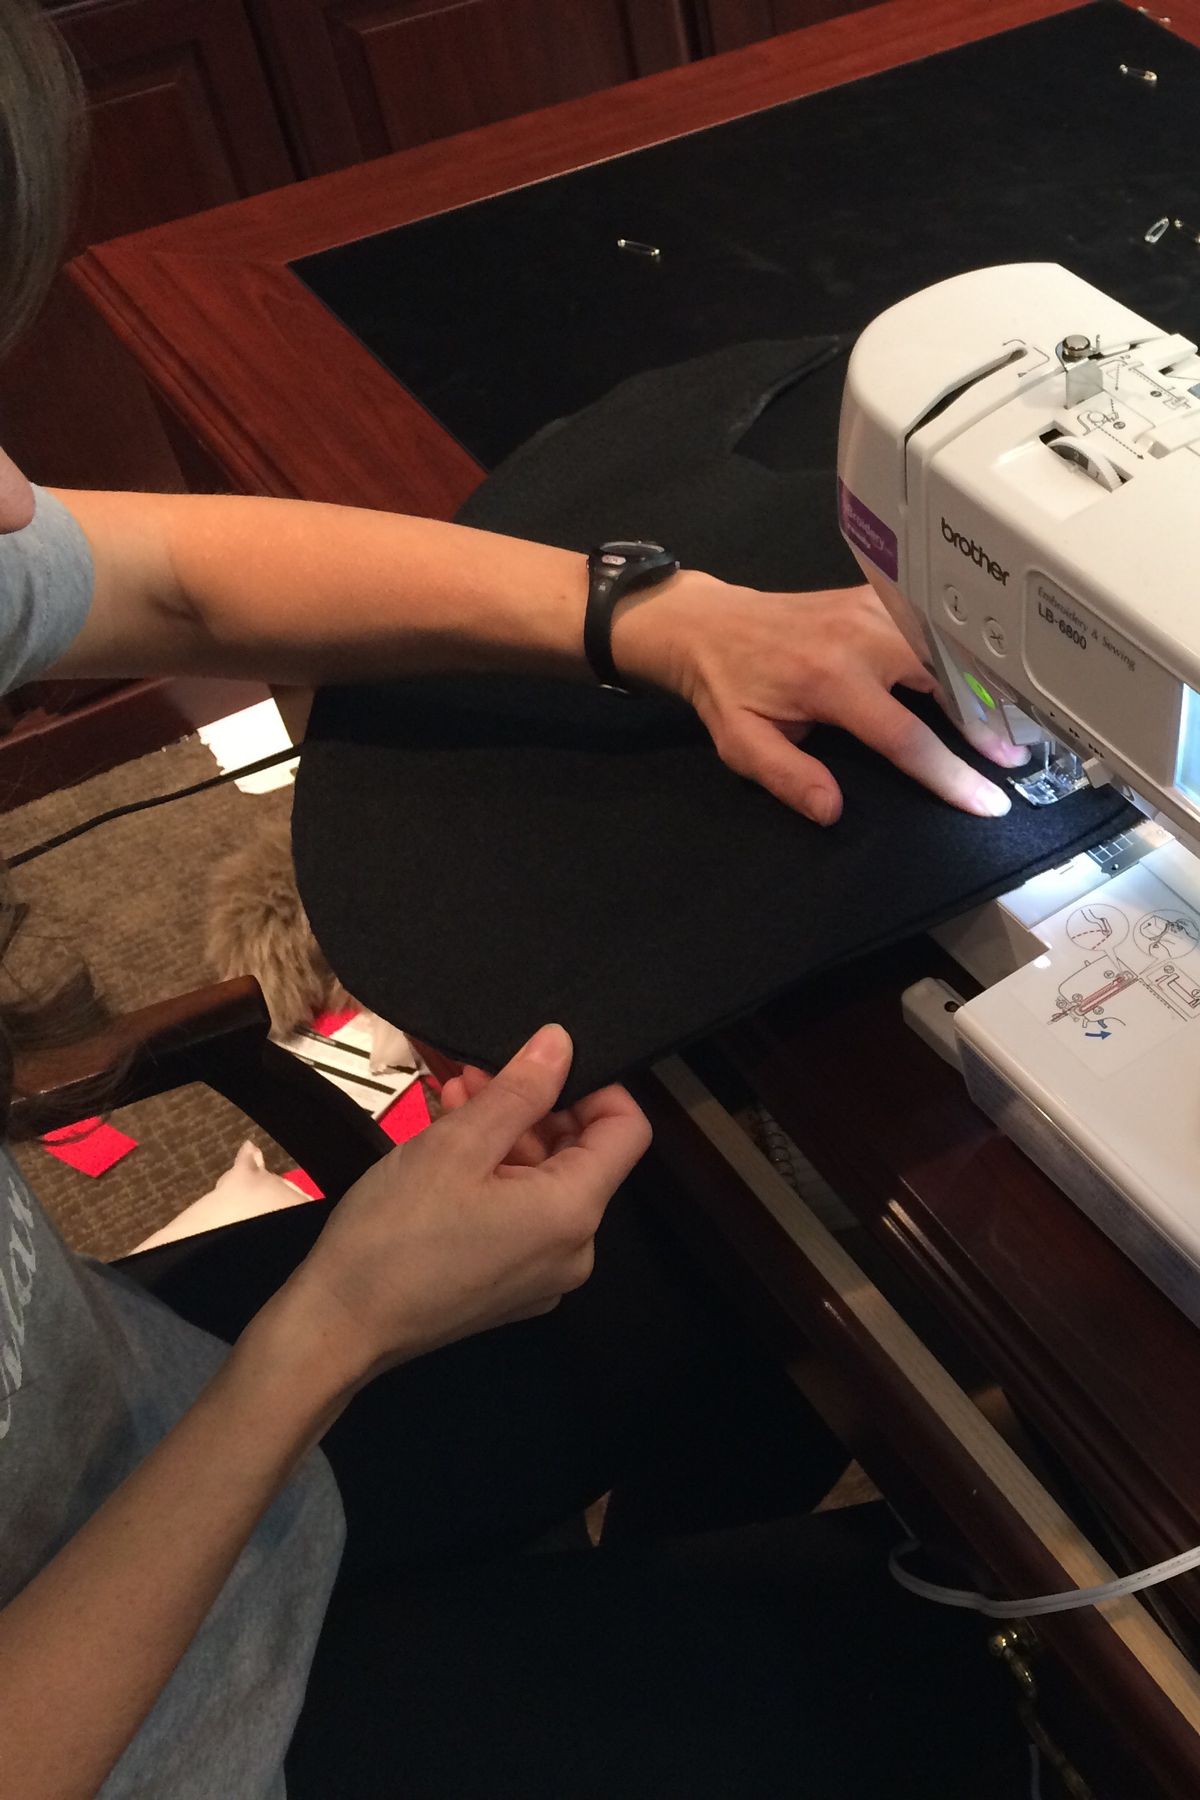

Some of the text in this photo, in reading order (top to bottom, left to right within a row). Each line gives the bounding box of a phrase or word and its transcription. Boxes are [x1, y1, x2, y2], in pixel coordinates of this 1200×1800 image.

[941, 516, 1010, 586] brother
[1038, 602, 1087, 650] LB-6800
[1038, 587, 1088, 632] Embroidery
[1102, 636, 1136, 672] Sewing
